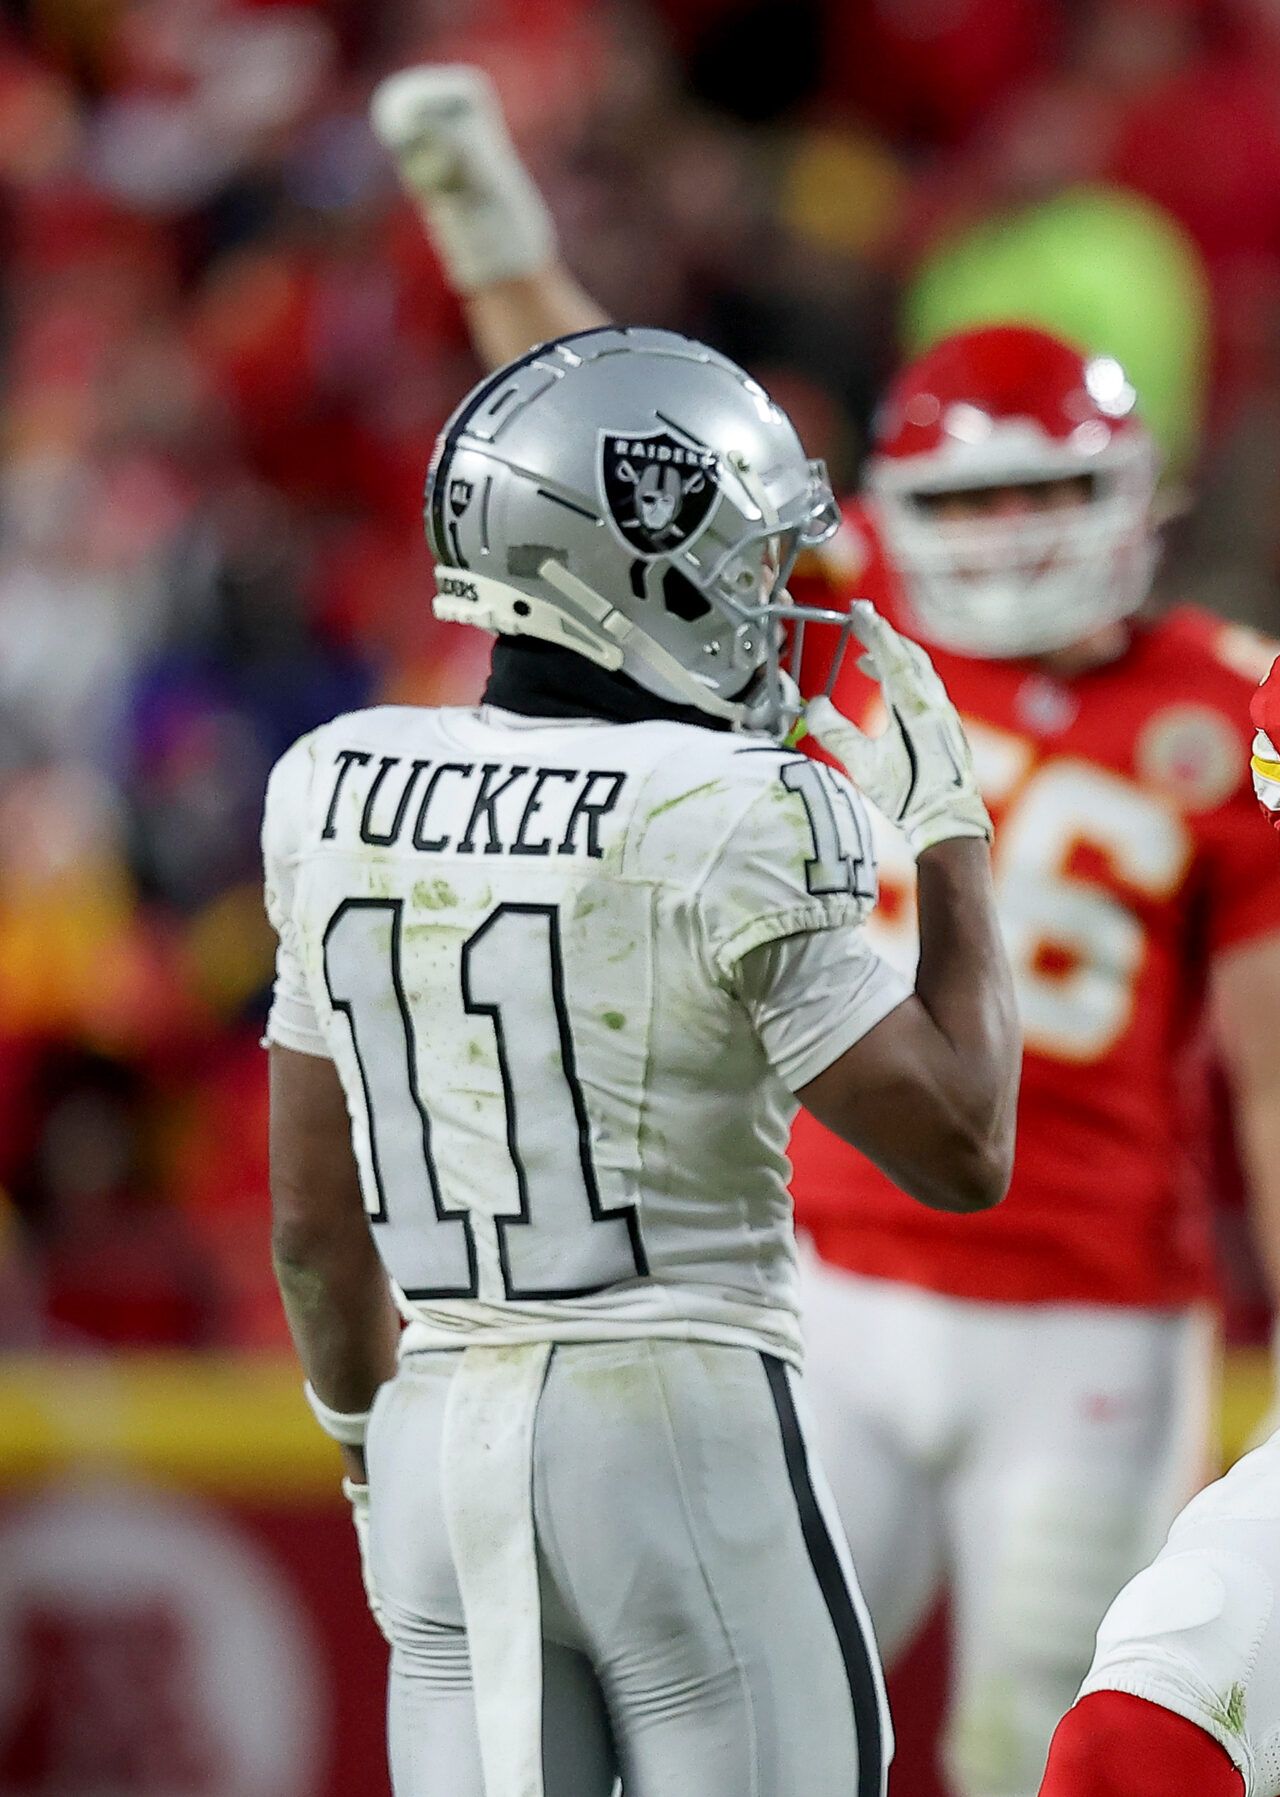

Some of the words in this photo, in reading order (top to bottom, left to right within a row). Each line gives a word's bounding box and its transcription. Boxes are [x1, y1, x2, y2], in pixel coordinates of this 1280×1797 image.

[321, 750, 628, 858] TUCKER
[780, 757, 877, 898] 11
[322, 897, 650, 1300] 11
